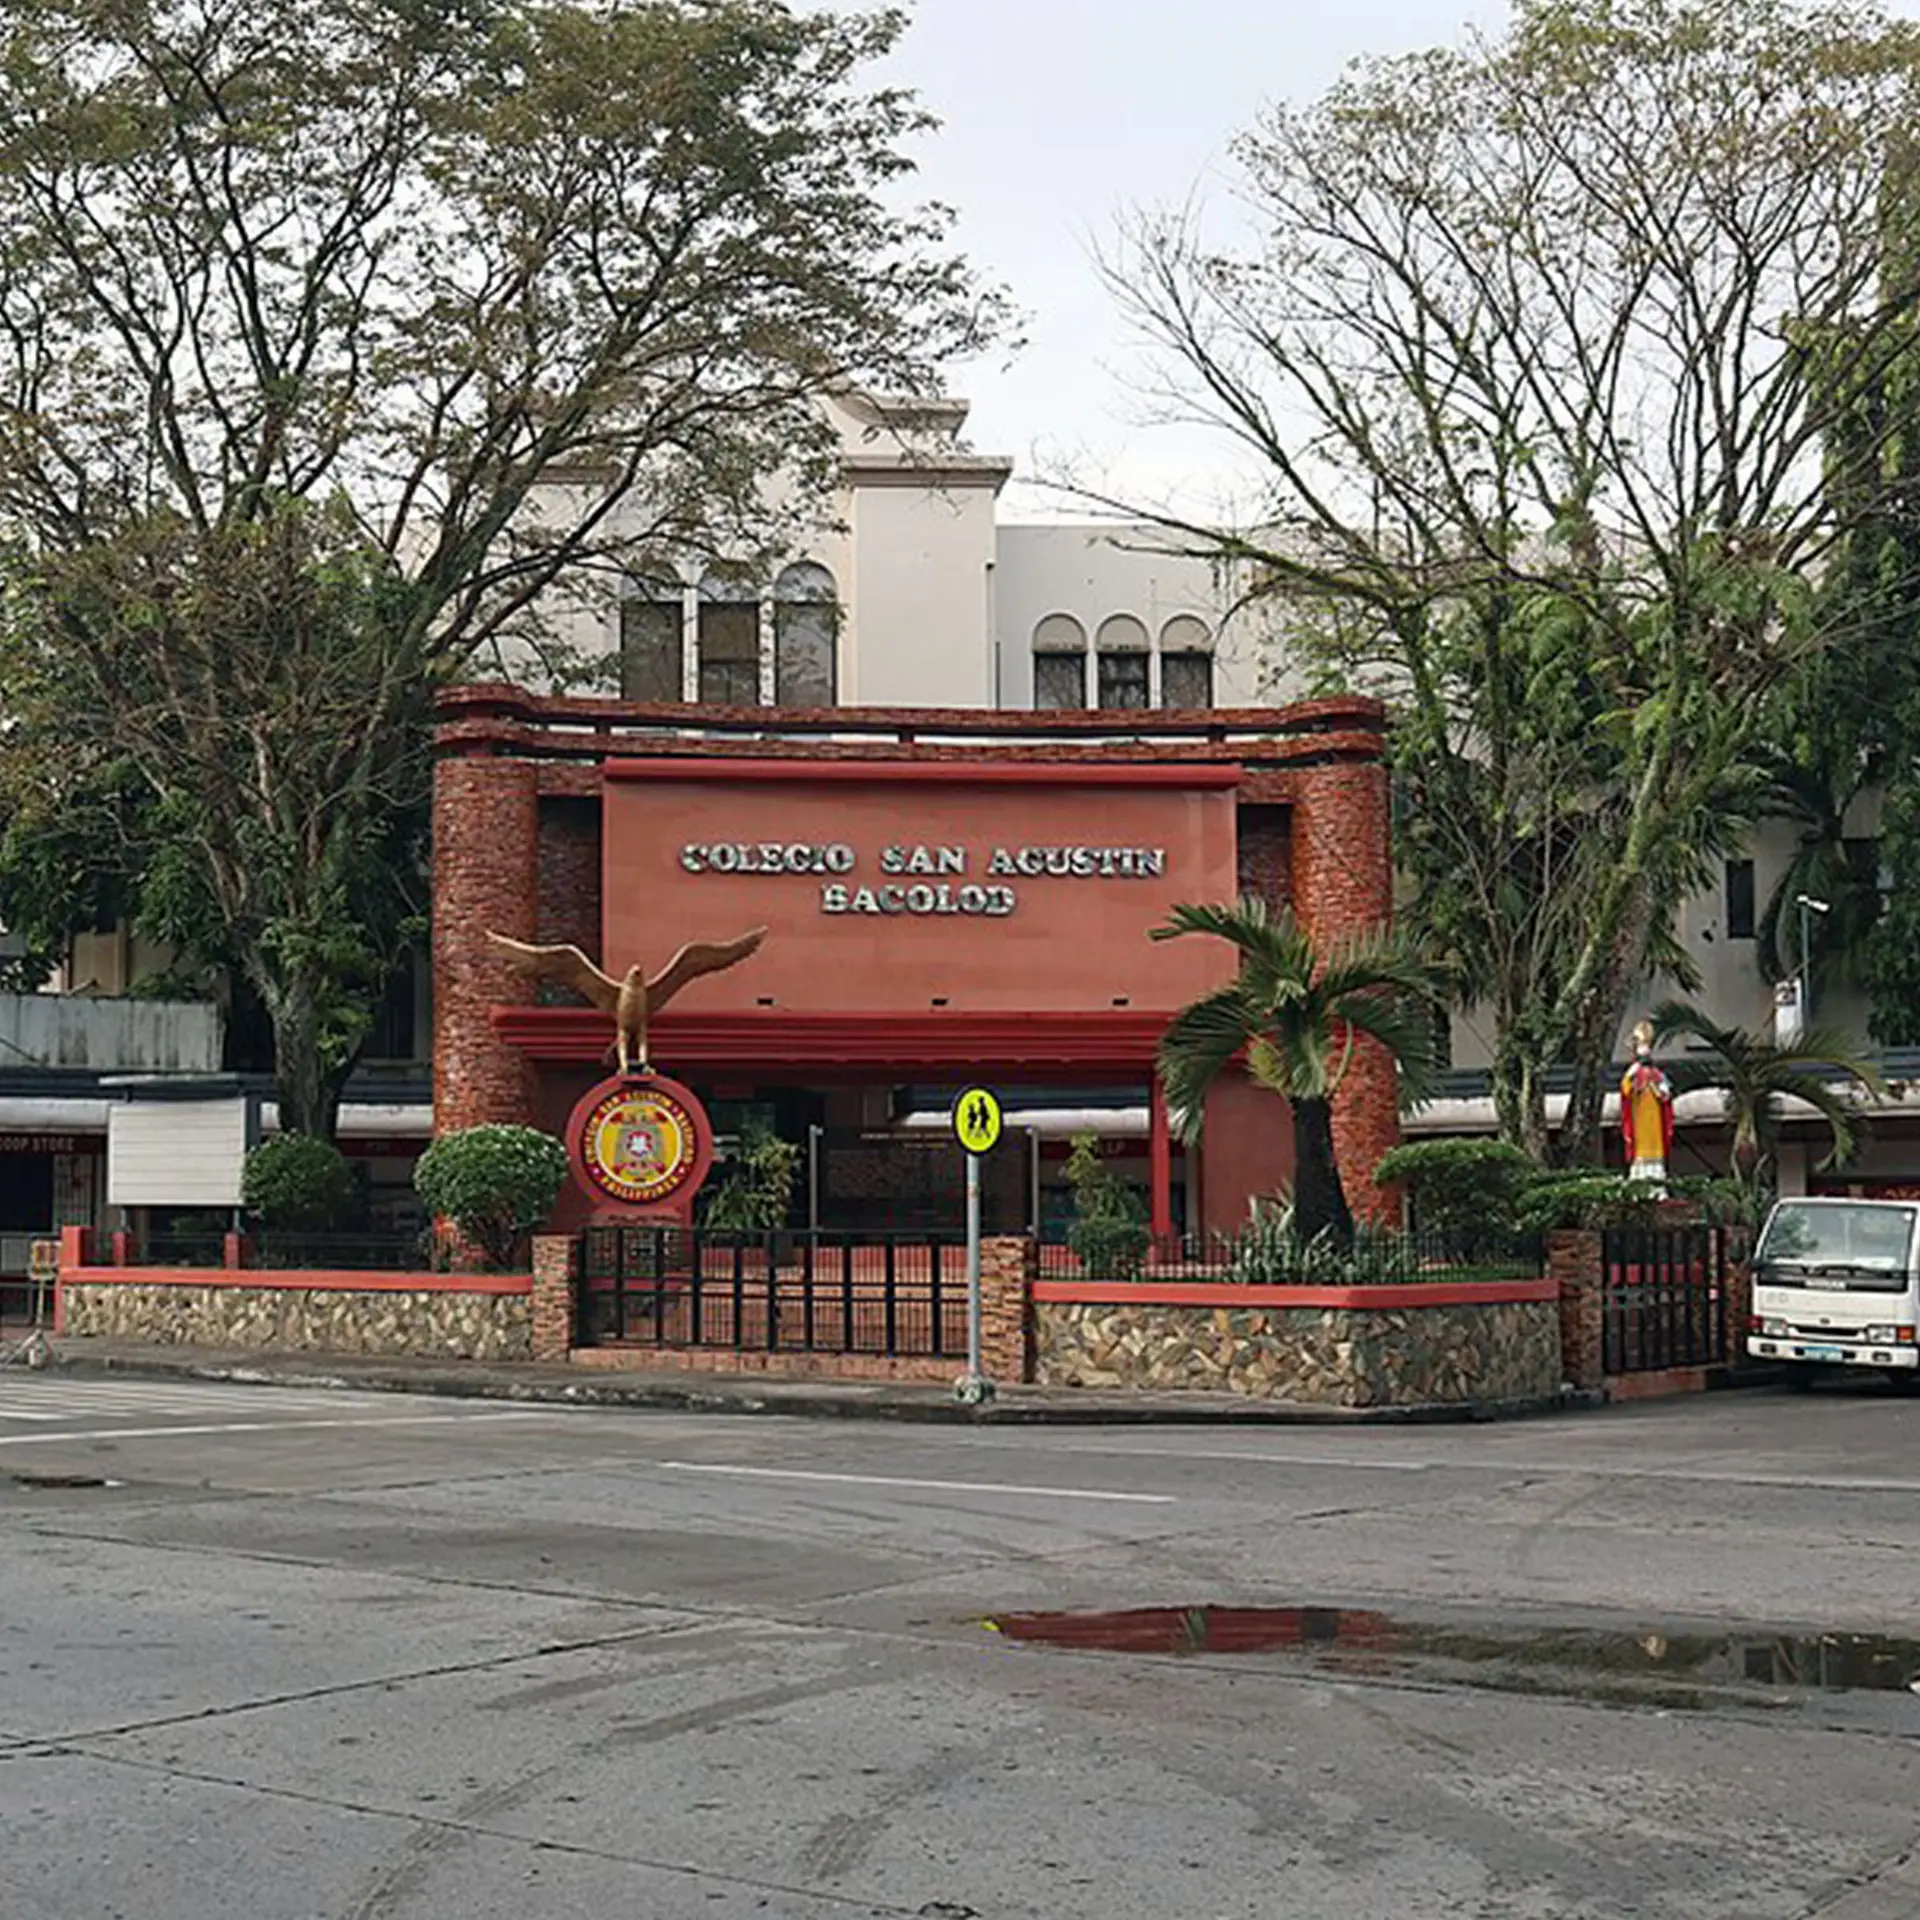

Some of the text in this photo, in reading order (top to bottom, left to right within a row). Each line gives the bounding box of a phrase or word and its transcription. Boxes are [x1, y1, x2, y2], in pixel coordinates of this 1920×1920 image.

[680, 843, 1165, 876] COLEGIO SAN AGUSTIN
[822, 884, 1016, 914] BACOLOD
